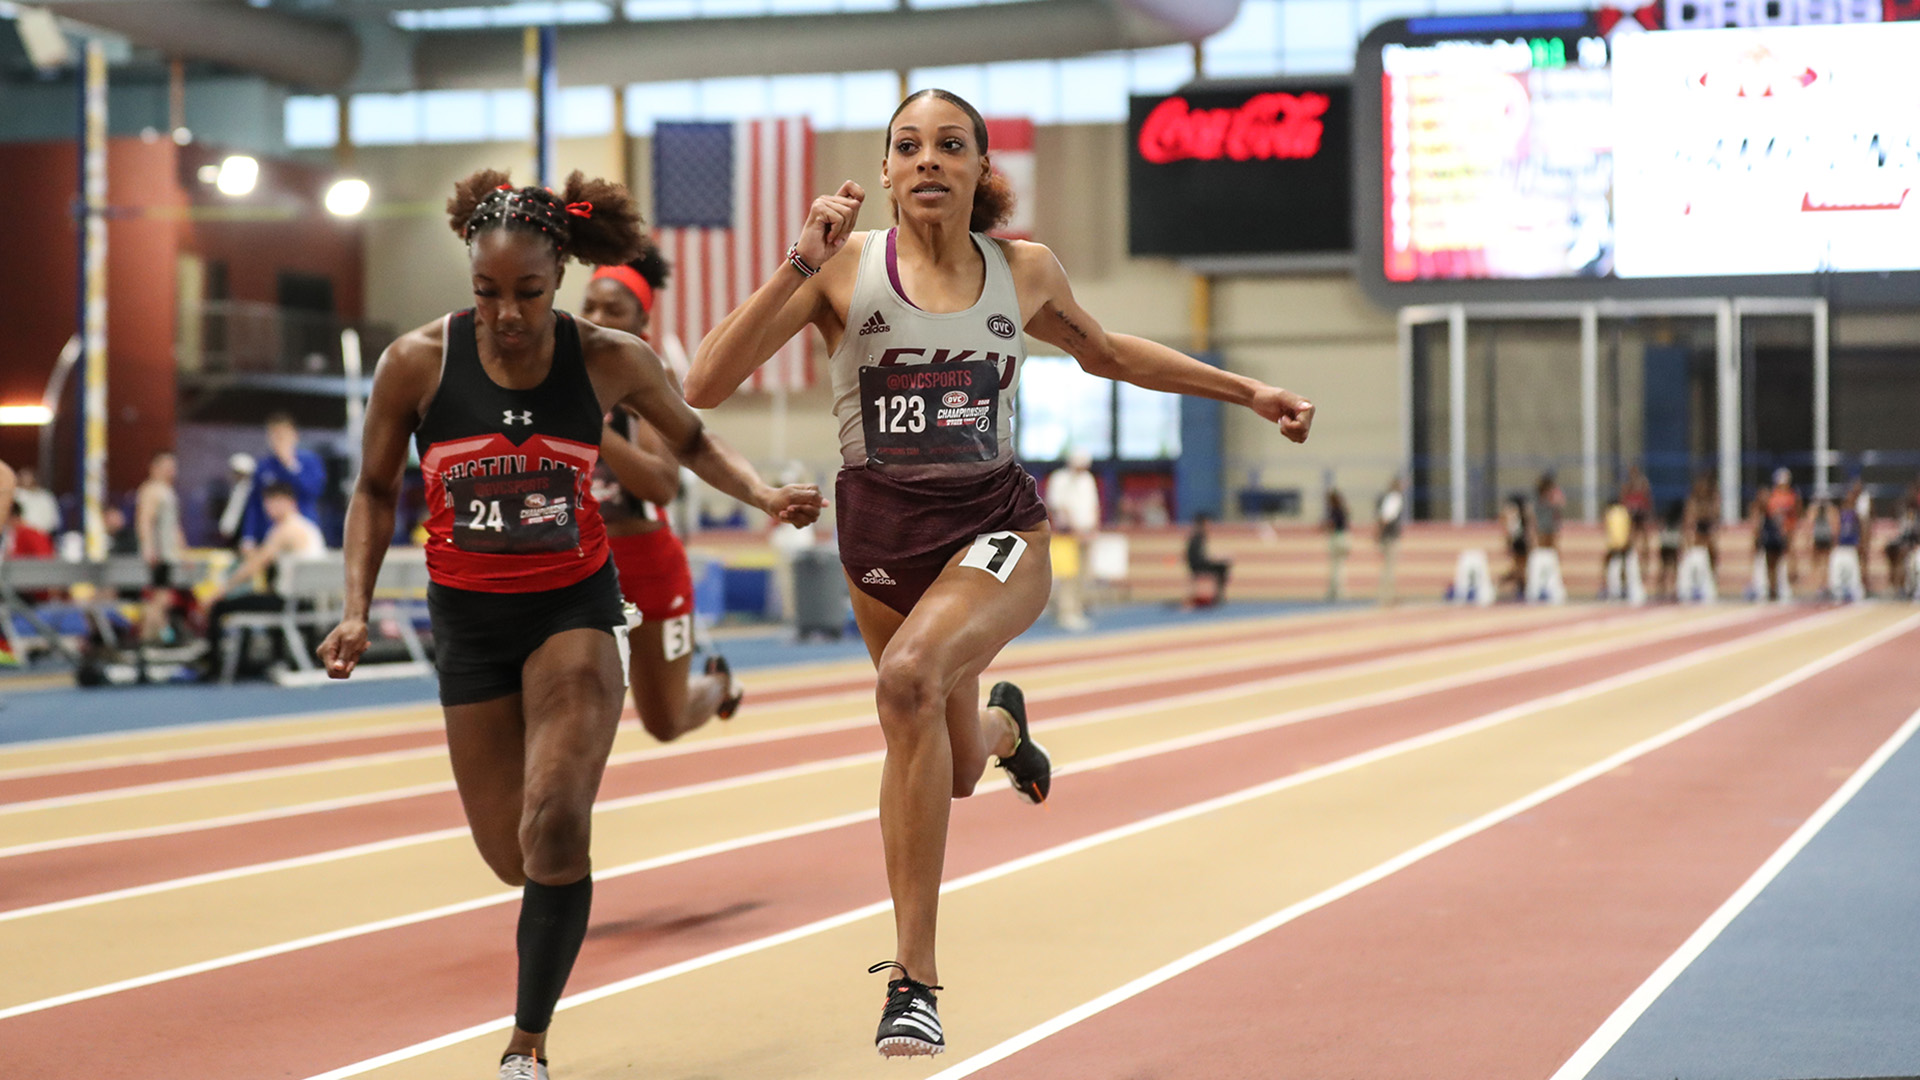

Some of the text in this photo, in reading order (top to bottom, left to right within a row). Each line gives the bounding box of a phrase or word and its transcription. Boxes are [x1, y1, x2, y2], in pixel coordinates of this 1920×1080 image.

[859, 323, 890, 336] adidas
[993, 321, 1010, 333] OVC
[887, 370, 972, 390] @OVCSPORTS
[874, 395, 926, 433] 123
[937, 406, 989, 419] CHAMPIONSHIP
[469, 499, 504, 532] 24
[986, 535, 1018, 574] 1
[862, 576, 897, 586] adidas
[673, 619, 685, 654] 3
